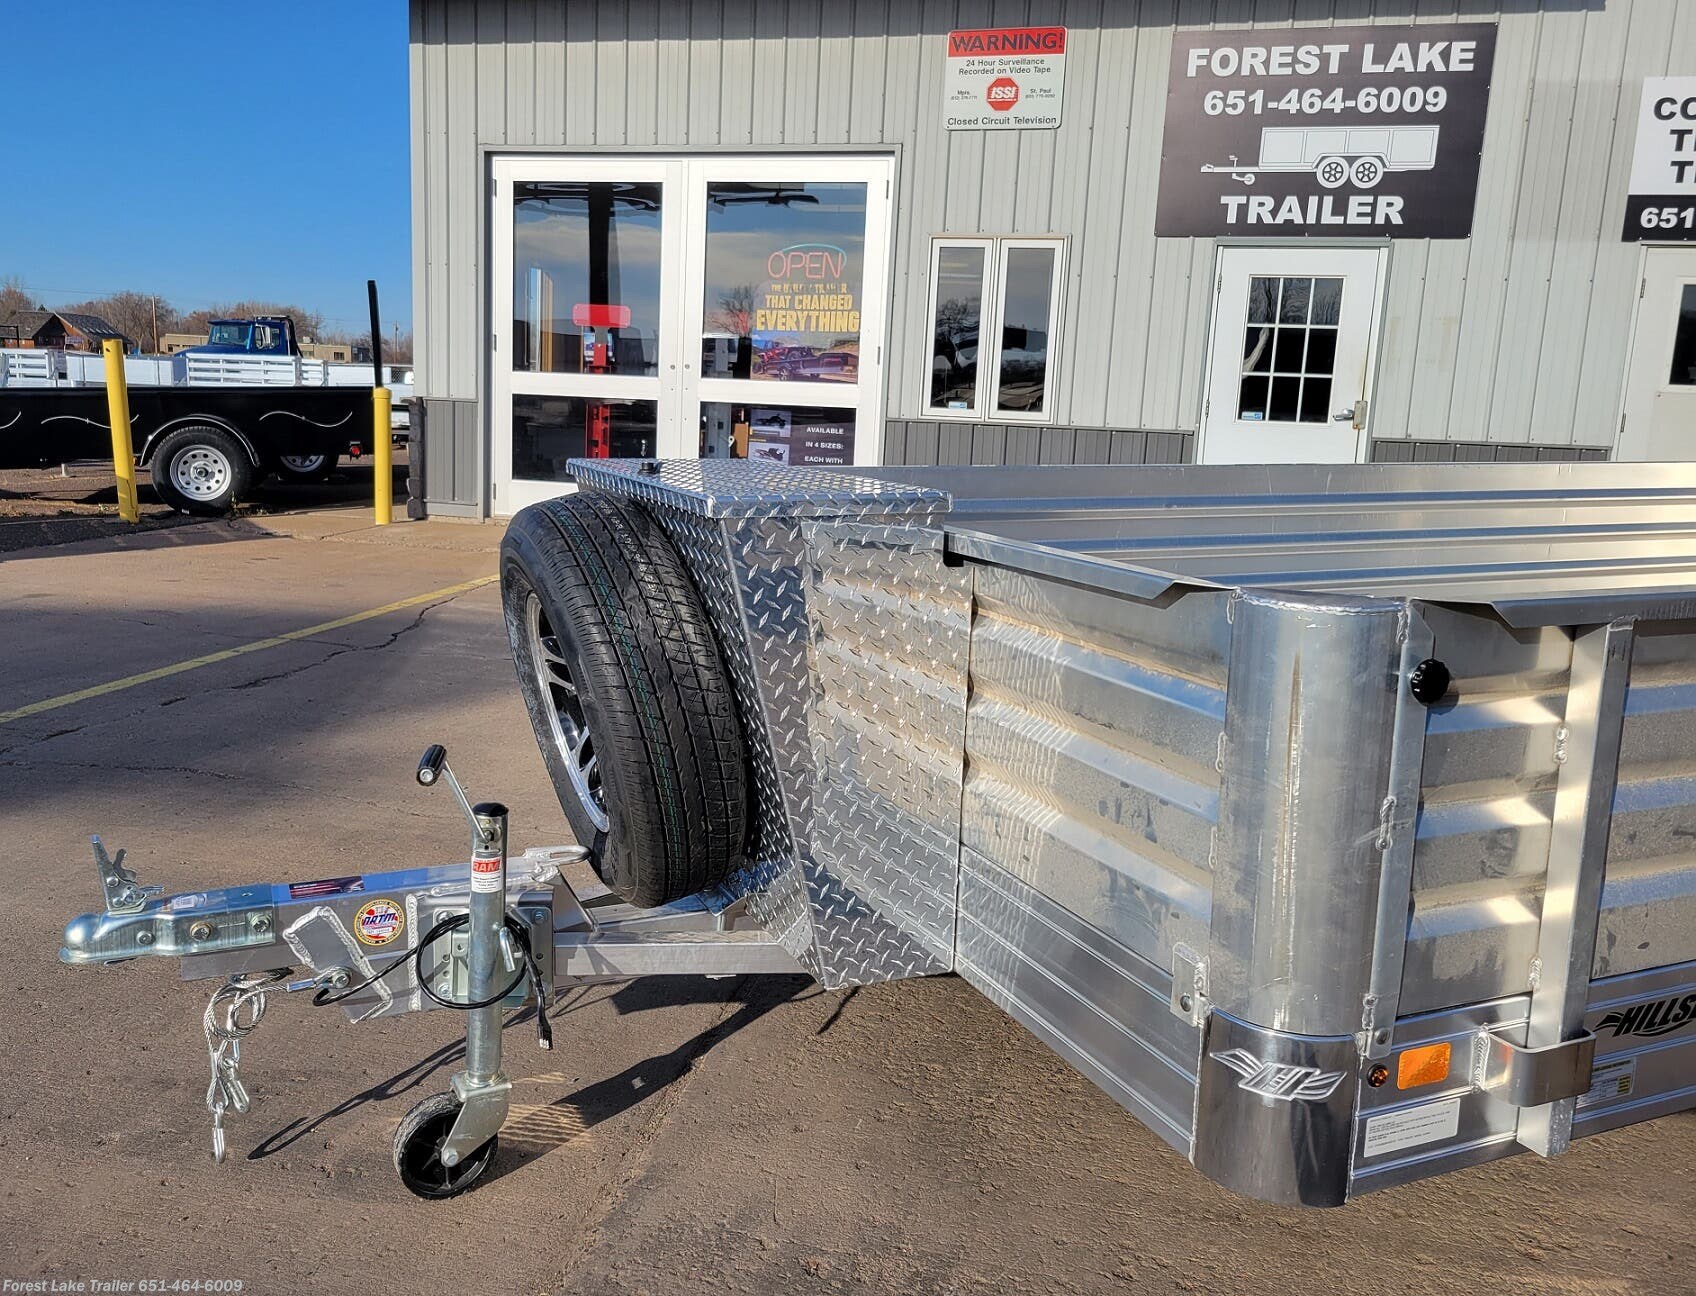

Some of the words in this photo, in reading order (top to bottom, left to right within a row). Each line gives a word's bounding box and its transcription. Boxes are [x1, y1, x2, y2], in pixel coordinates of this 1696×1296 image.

[952, 32, 1063, 52] WARNING!
[958, 67, 994, 75] Recorded
[1034, 66, 1051, 75] Tape
[966, 59, 975, 67] 24
[978, 59, 995, 67] Hour
[998, 58, 1045, 66] Surveillance
[1186, 44, 1349, 77] FOREST
[1361, 41, 1477, 74] LAKE
[1203, 86, 1448, 116] 651-464-6009
[947, 117, 979, 126] Closed
[981, 116, 1010, 125] Circuit
[1013, 115, 1057, 124] Television
[1669, 129, 1696, 152] T
[1670, 160, 1696, 184] T
[1220, 195, 1404, 225] TRAILER
[767, 251, 842, 279] OPEN
[765, 295, 791, 309] THAT
[794, 294, 853, 310] CHANGED
[756, 309, 860, 333] EVERYTHING
[806, 426, 845, 435] AVAILABLE
[804, 455, 824, 463] EACH
[1612, 993, 1696, 1037] HILLS
